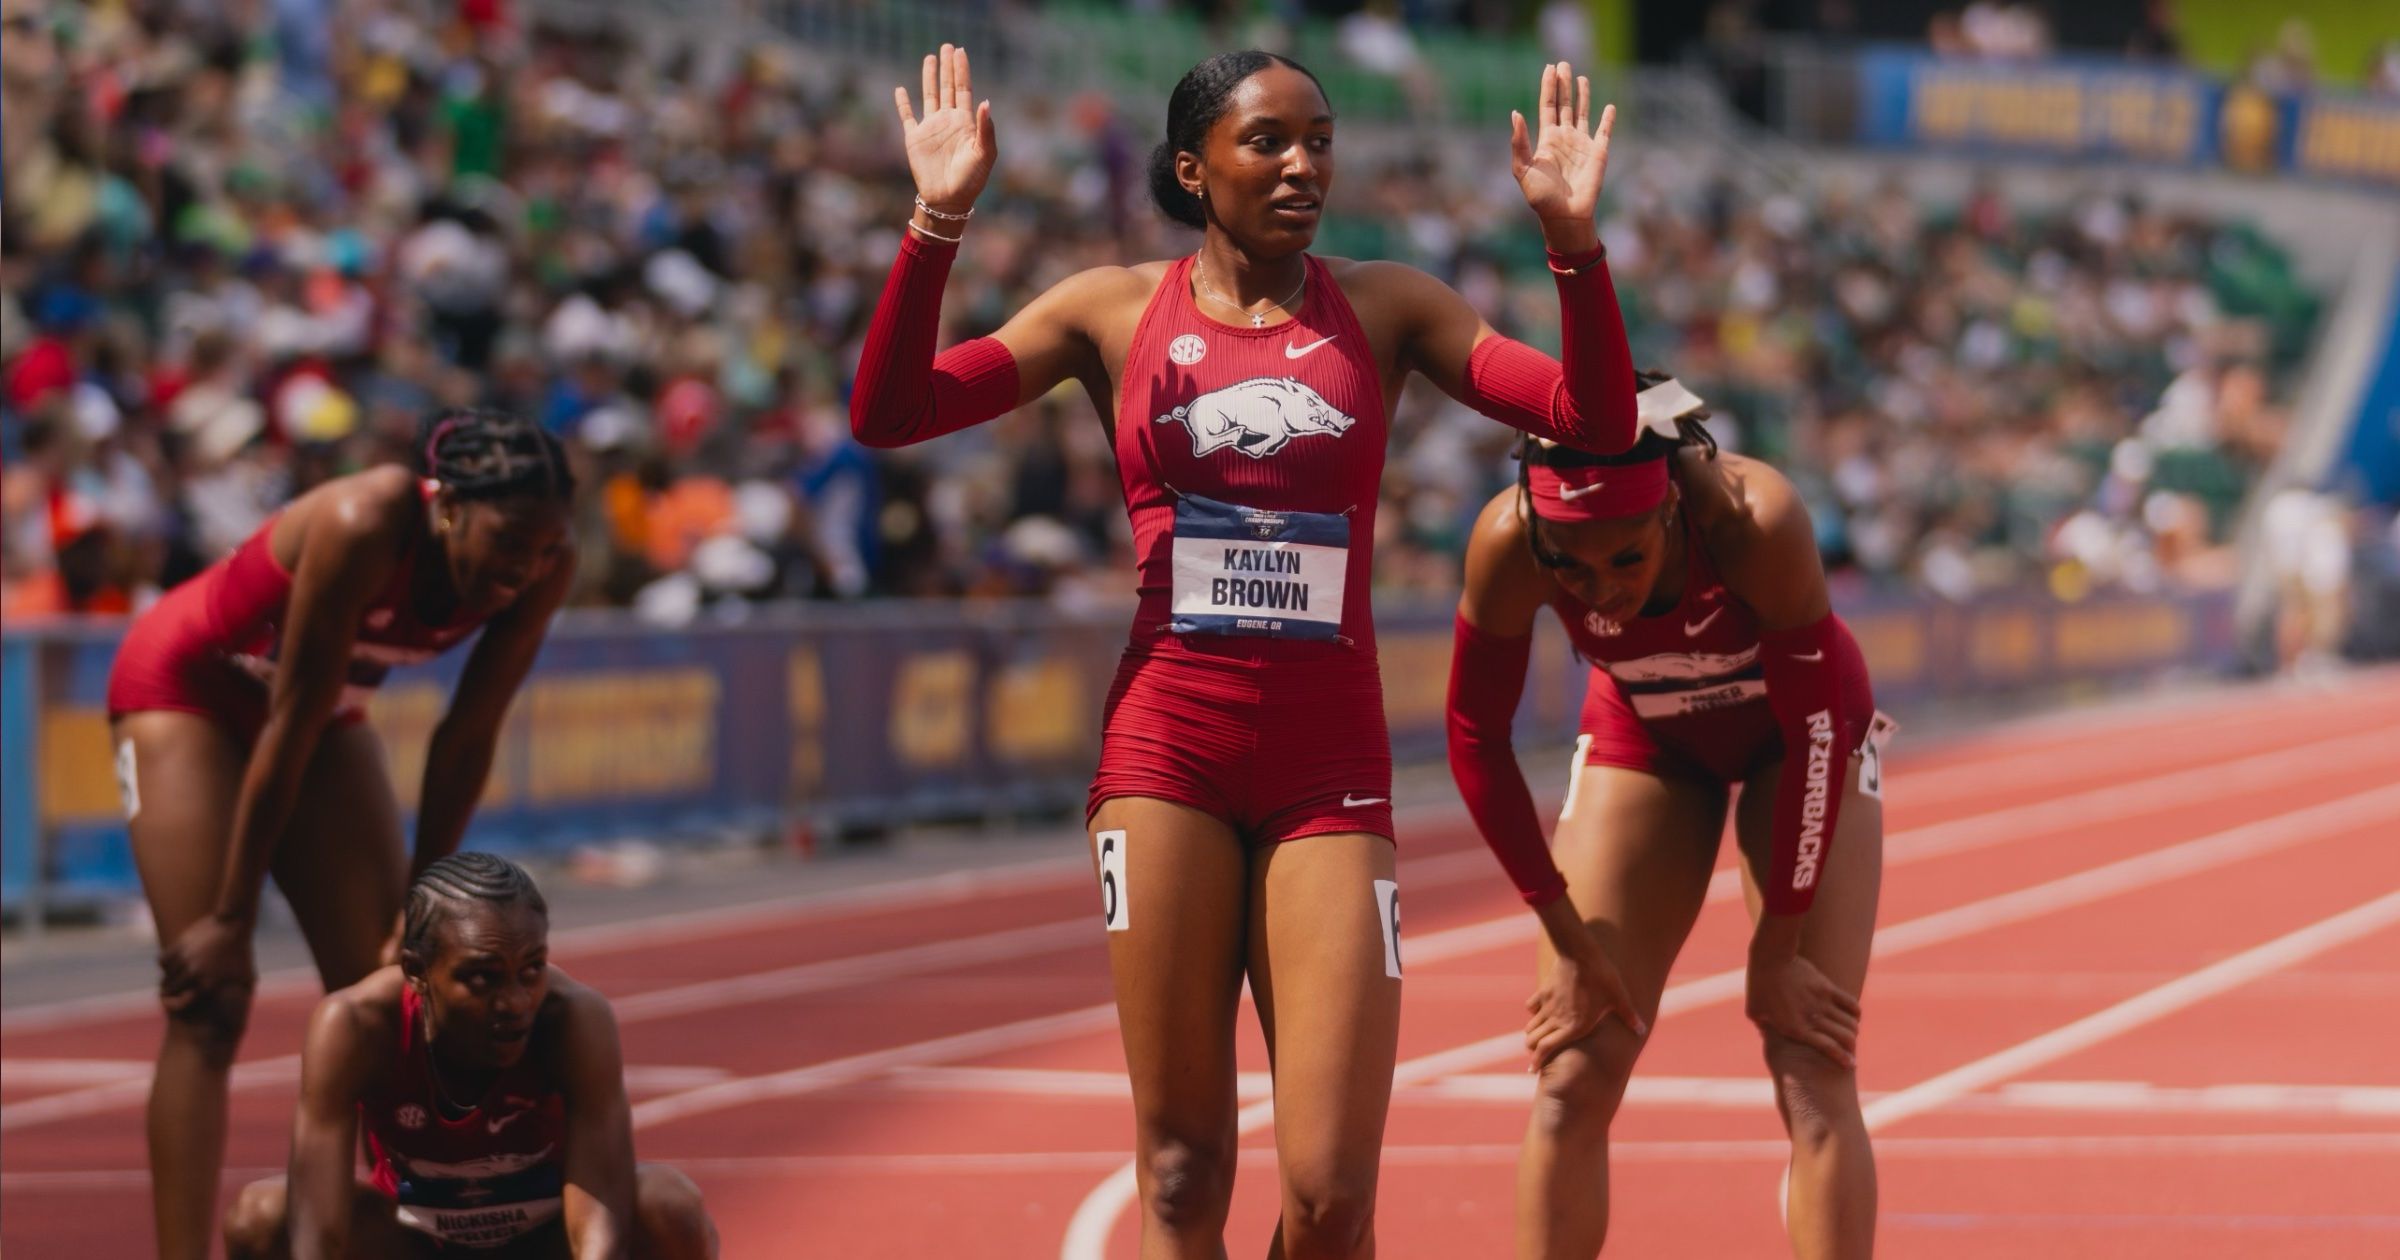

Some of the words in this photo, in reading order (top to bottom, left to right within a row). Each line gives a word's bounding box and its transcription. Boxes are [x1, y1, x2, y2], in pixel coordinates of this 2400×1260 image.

[1171, 336, 1204, 363] SEC
[1223, 548, 1301, 575] KAYLYN
[1211, 577, 1309, 612] BROWN
[1270, 621, 1282, 630] OR
[1102, 837, 1117, 927] 6
[398, 1106, 427, 1128] SEC
[436, 1208, 528, 1231] NICKISHA
